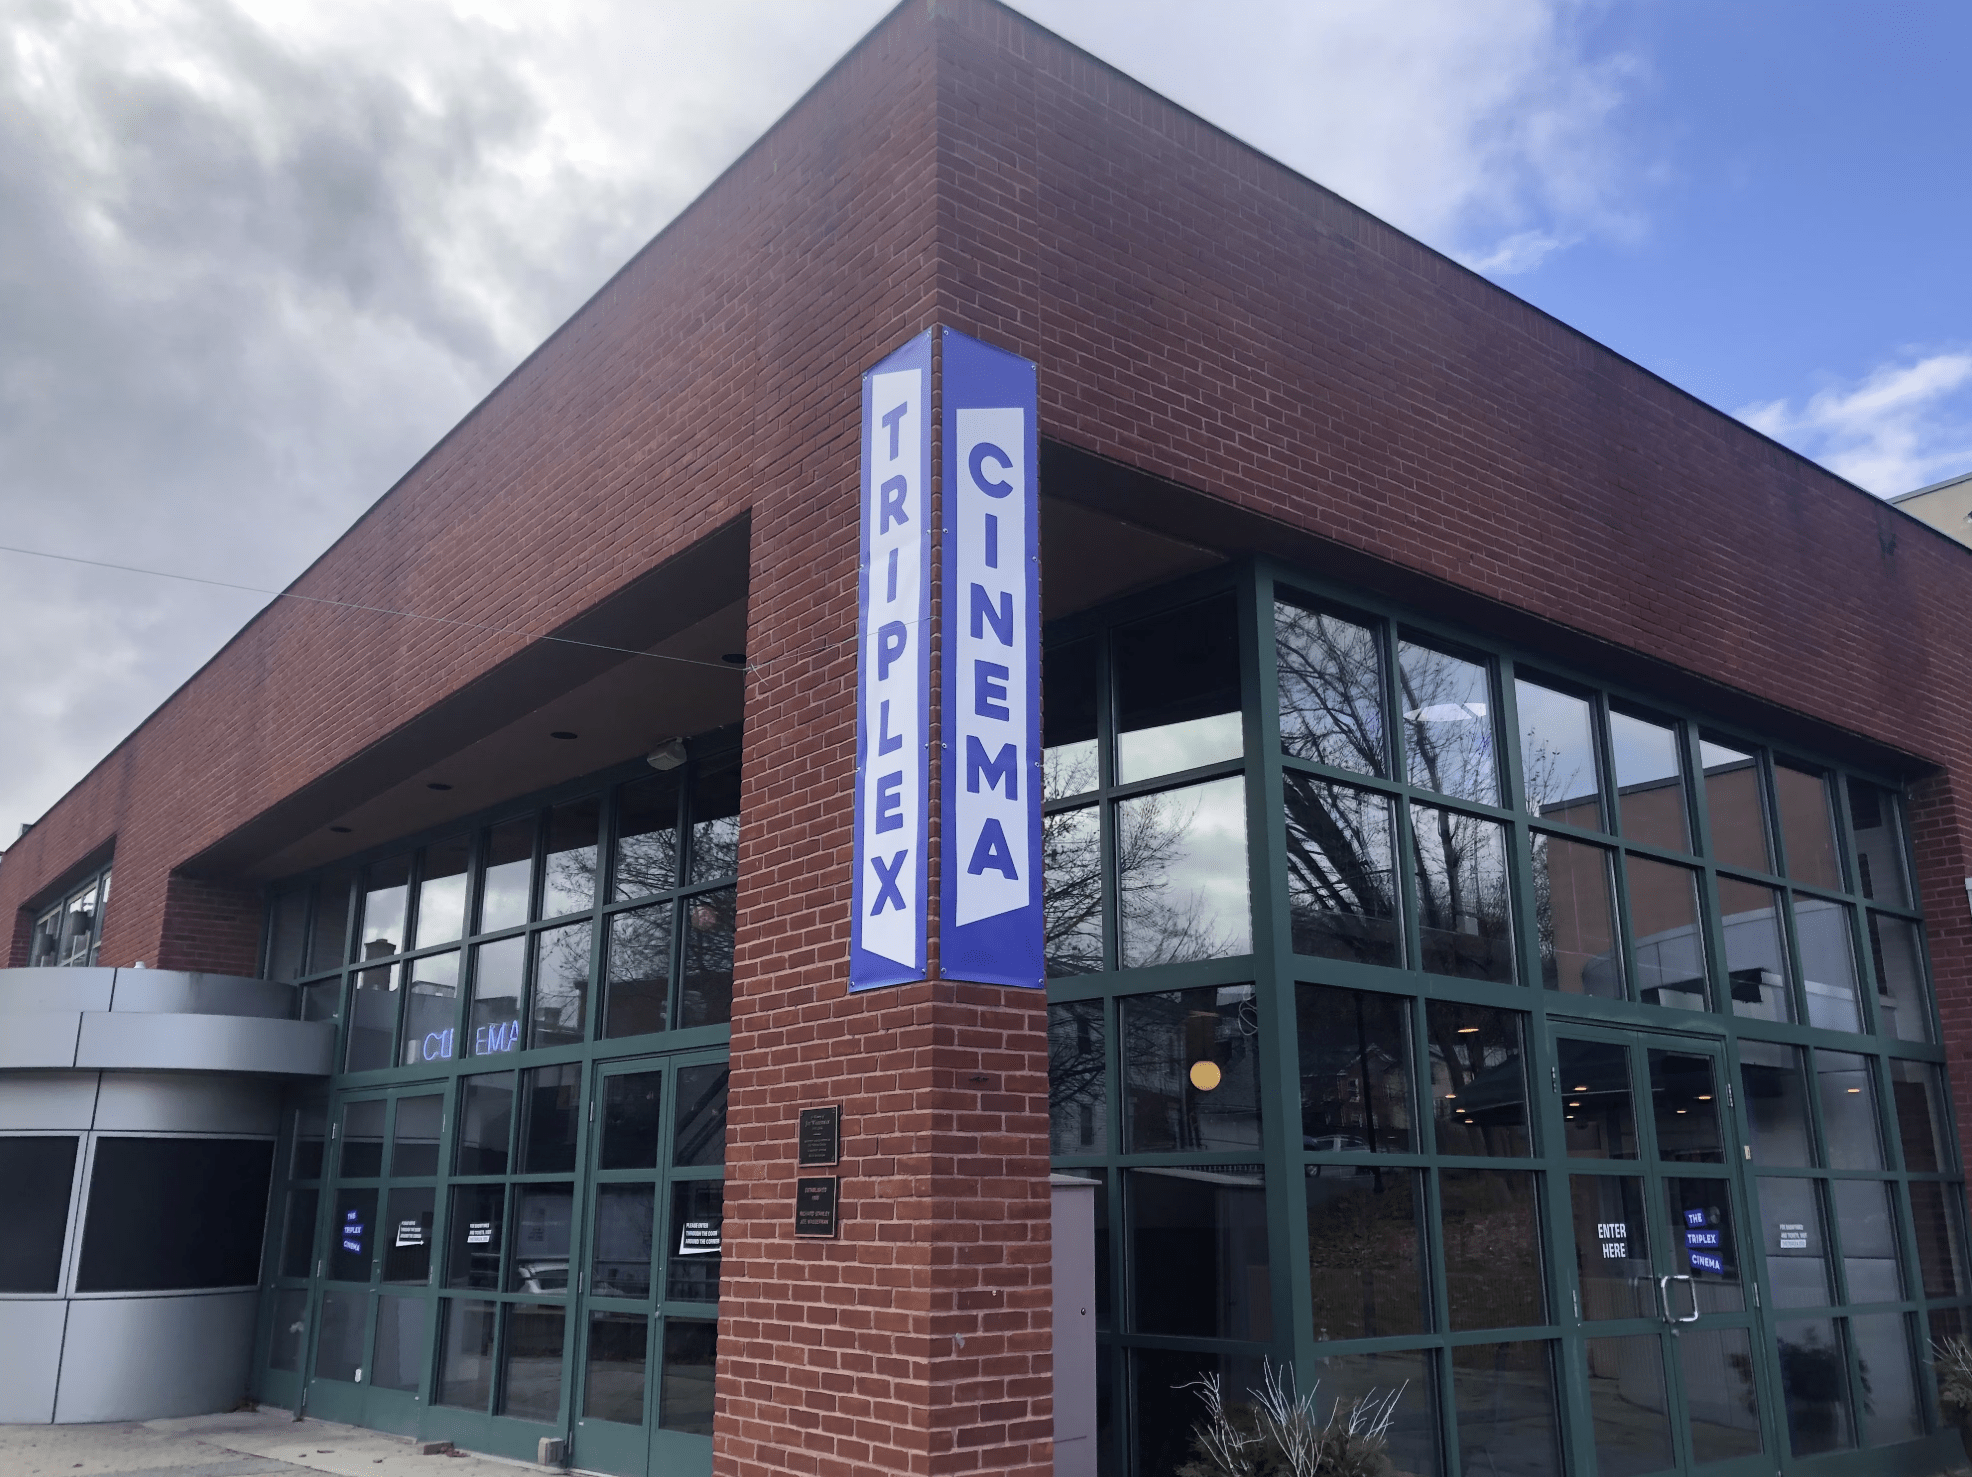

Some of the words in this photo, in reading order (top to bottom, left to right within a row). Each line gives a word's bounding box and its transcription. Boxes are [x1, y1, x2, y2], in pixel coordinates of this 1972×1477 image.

[869, 401, 909, 917] TRIPLEX
[966, 441, 1020, 881] CINEMA
[1688, 1213, 1703, 1224] THE
[1597, 1223, 1627, 1239] ENTER
[1687, 1233, 1717, 1244] TRIPLEX
[1602, 1242, 1626, 1259] HERE
[1691, 1254, 1721, 1270] CINEMA
